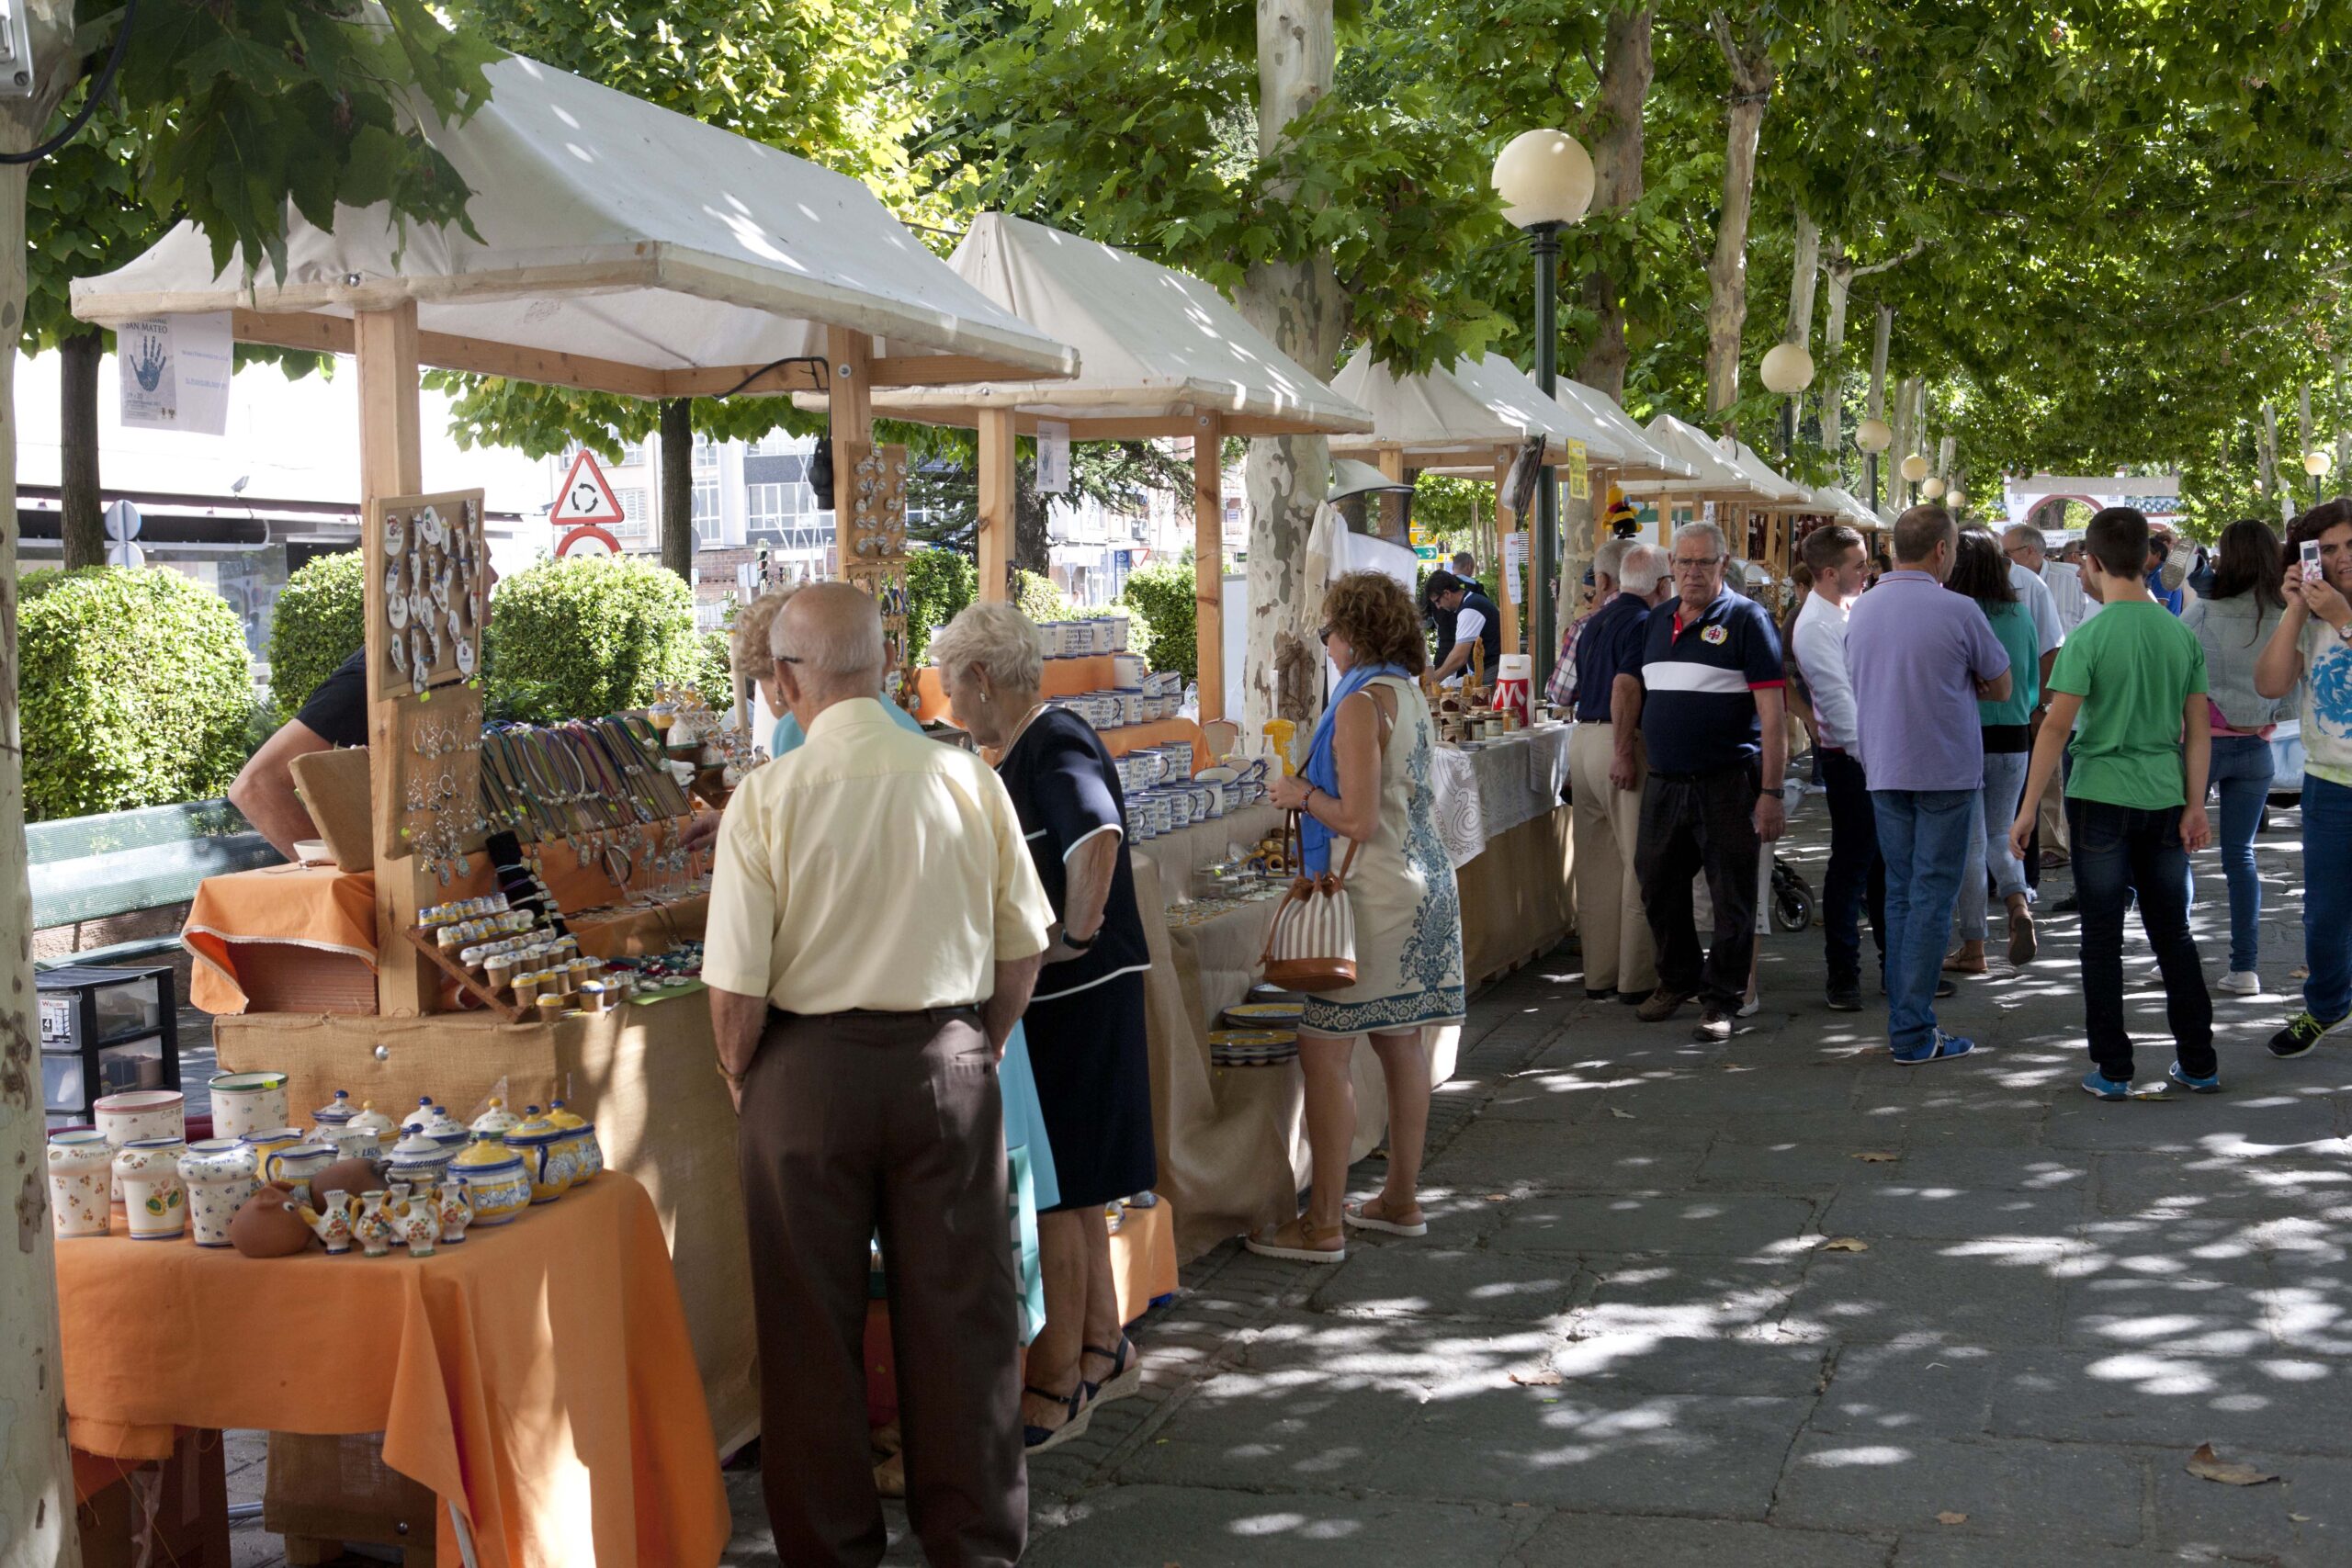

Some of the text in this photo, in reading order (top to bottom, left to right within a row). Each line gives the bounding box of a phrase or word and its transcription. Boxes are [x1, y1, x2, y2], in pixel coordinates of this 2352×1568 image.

[126, 322, 167, 334] SAN MATEO
[44, 1019, 51, 1028] 4
